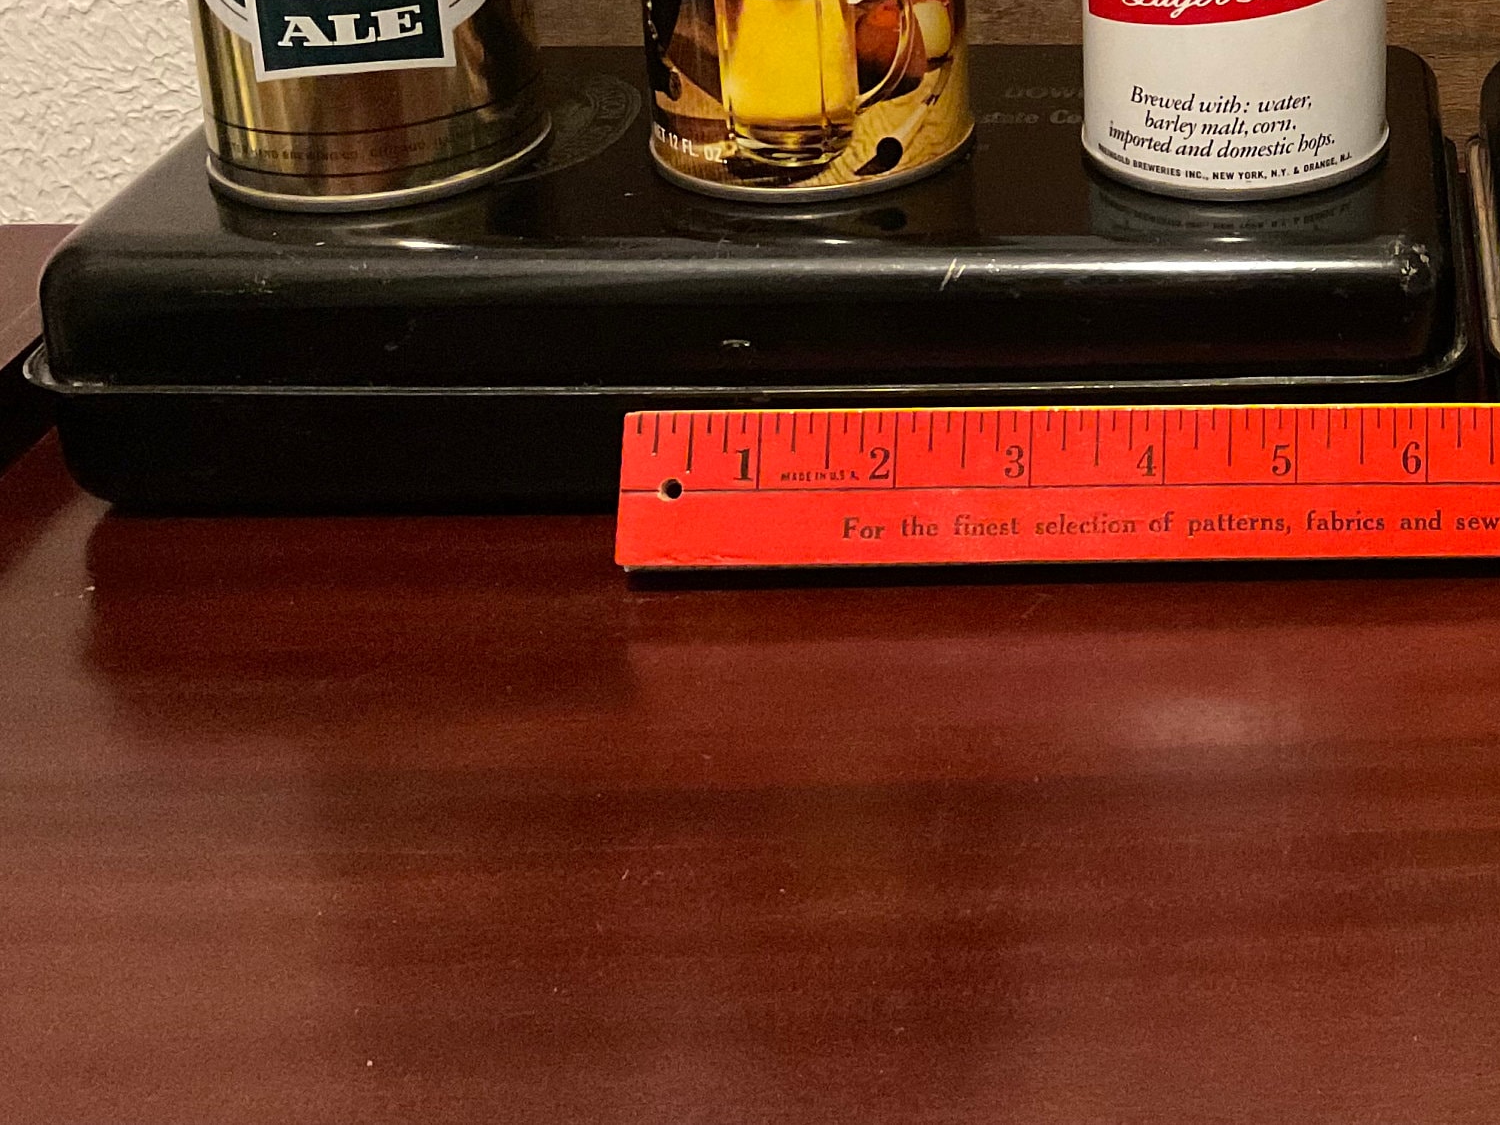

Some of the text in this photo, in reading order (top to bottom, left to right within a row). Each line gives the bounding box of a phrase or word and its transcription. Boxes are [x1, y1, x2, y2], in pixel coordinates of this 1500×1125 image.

[279, 4, 426, 47] ALE
[1131, 85, 1312, 114] Brewed with: water,
[1109, 120, 1336, 159] imported and domestic hops.
[1145, 110, 1197, 140] barley
[1201, 117, 1249, 137] malt,
[669, 132, 678, 150] 12
[704, 145, 728, 164] OZ.
[1133, 160, 1181, 177] BREWERIES
[1212, 171, 1234, 180] NEW
[1238, 170, 1268, 180] YORK,
[1293, 166, 1300, 175] &
[1303, 157, 1338, 173] ORANGE,
[733, 448, 753, 481] 1
[869, 447, 890, 480] 2
[1004, 445, 1025, 478] 3
[1136, 445, 1156, 477] 4
[1271, 444, 1292, 476] 5
[1401, 442, 1422, 474] 6
[781, 471, 811, 481] MADE
[815, 472, 826, 480] IN
[842, 517, 885, 540] For
[901, 515, 938, 536] the
[953, 515, 1019, 536] finest
[1035, 514, 1137, 536] selection
[1148, 512, 1175, 533] of
[1187, 512, 1292, 538] patterns,
[1306, 510, 1385, 532] fabrics
[1400, 510, 1442, 532] and
